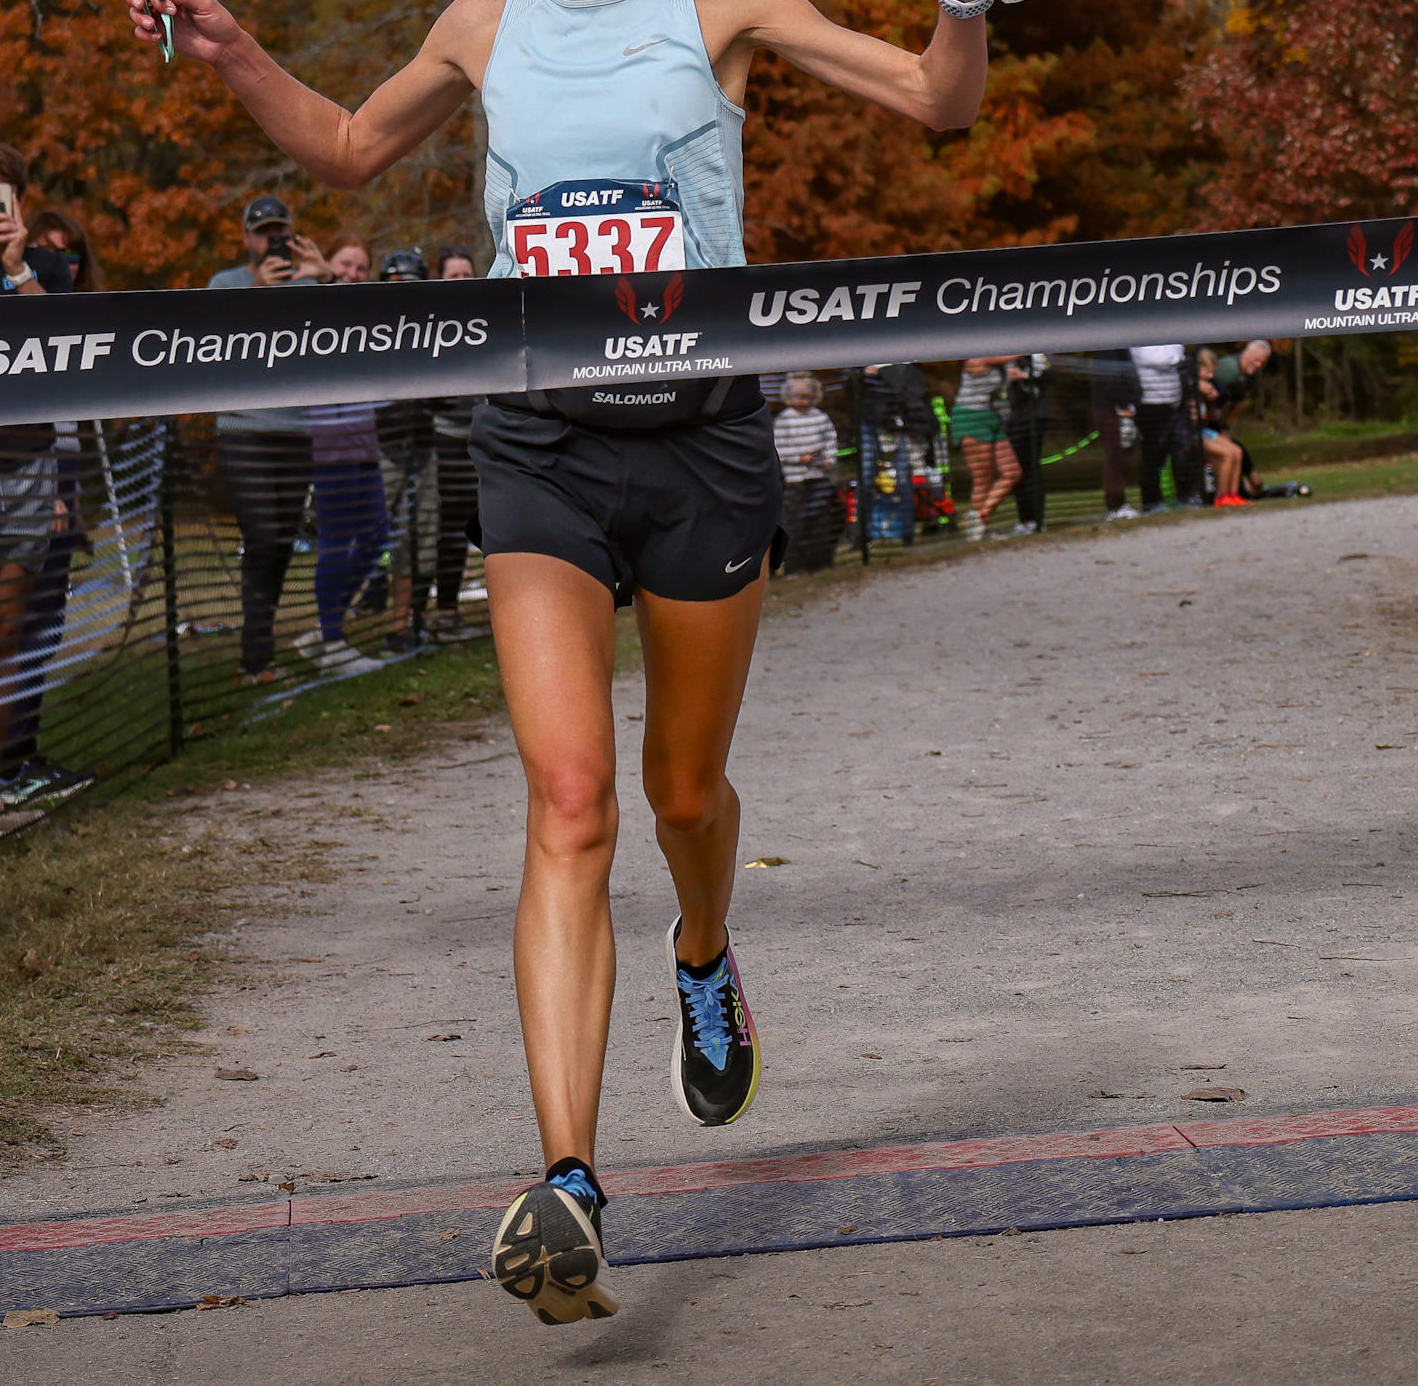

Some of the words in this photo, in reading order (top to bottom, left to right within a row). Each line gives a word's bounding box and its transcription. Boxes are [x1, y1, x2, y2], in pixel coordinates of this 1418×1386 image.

[560, 189, 624, 207] USATF
[514, 216, 674, 278] 5337
[748, 281, 922, 327] USATF
[936, 260, 1282, 316] Championships
[1304, 314, 1375, 330] MOUNTAIN
[131, 313, 489, 368] Championships
[604, 331, 699, 360] USATF
[573, 364, 646, 379] MOUNTAIN
[648, 360, 692, 374] ULTRA
[694, 357, 734, 371] TRAIL
[592, 391, 677, 405] SALOMON
